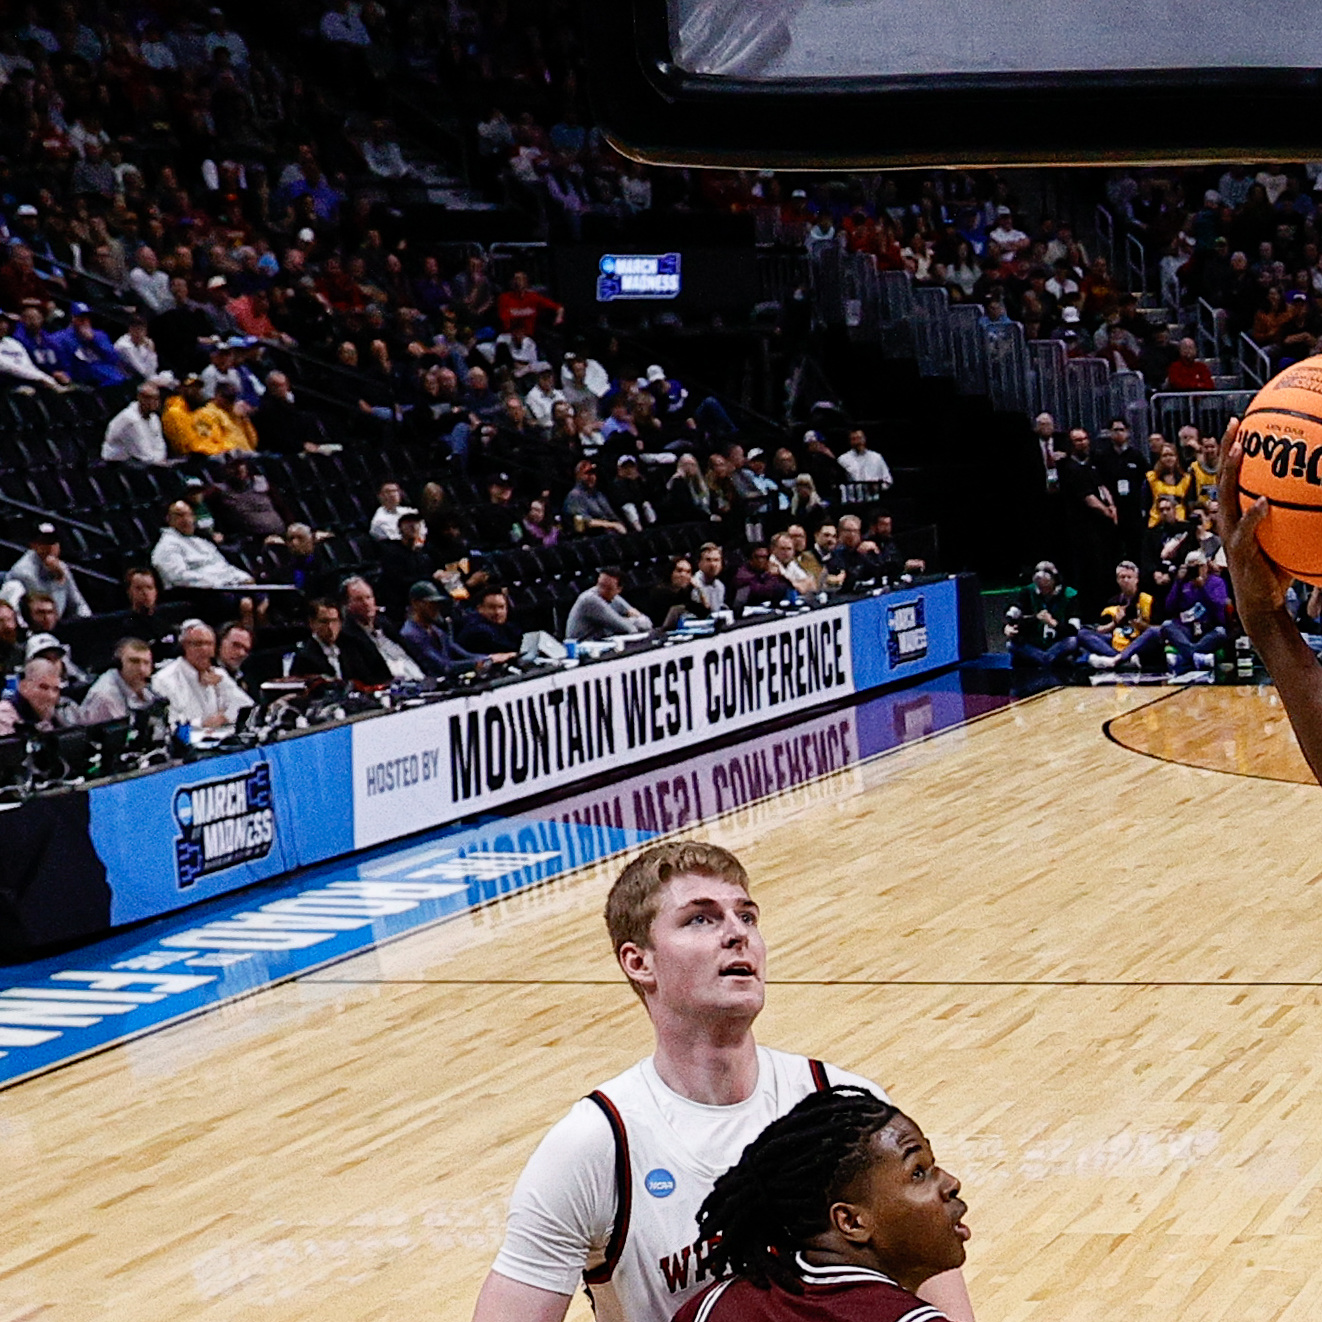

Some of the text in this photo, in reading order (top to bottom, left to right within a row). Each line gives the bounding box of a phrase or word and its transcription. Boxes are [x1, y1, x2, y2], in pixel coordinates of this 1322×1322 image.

[366, 617, 846, 803] HOSTED BY MOUNTAIN WEST CONFERENCE
[192, 779, 247, 827] MARCH
[203, 808, 273, 861] MADNESS
